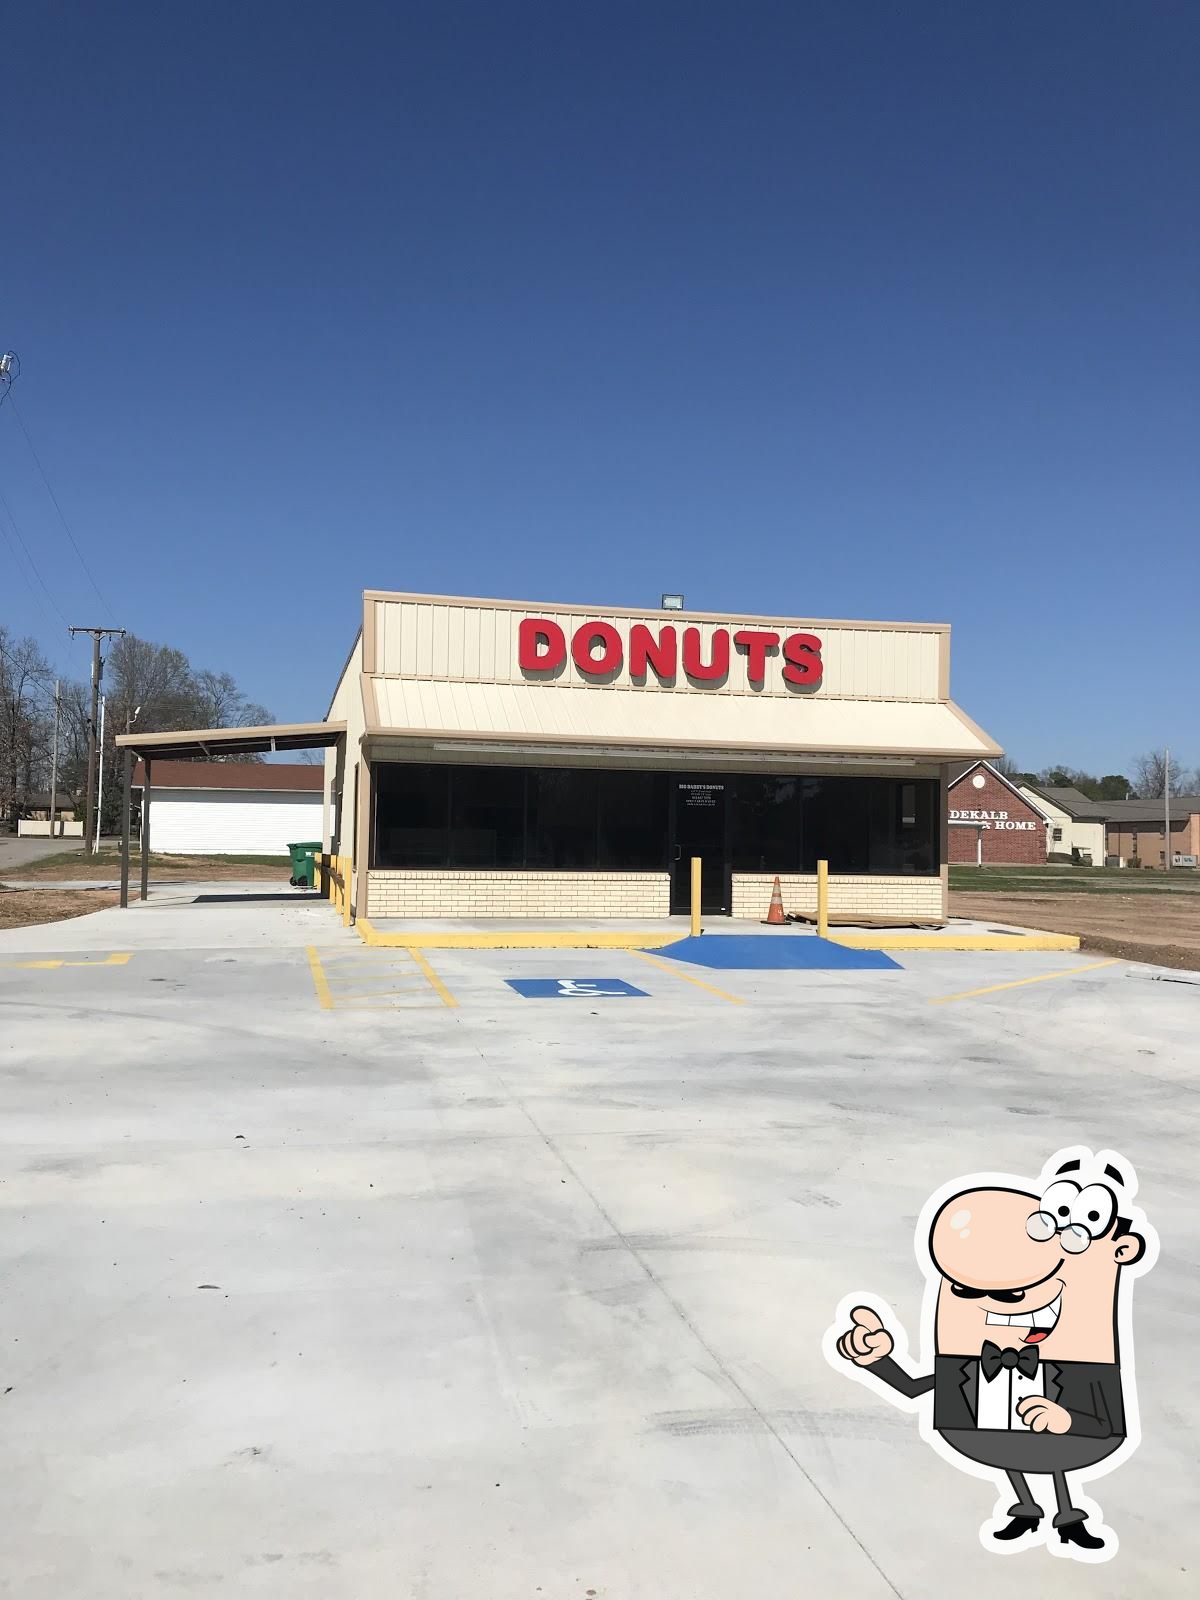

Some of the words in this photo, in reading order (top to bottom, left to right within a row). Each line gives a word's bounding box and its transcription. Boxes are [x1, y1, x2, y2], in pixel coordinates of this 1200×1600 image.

[519, 618, 824, 685] DONUTS
[949, 810, 1009, 820] DEKALB
[994, 821, 1037, 831] HOME
